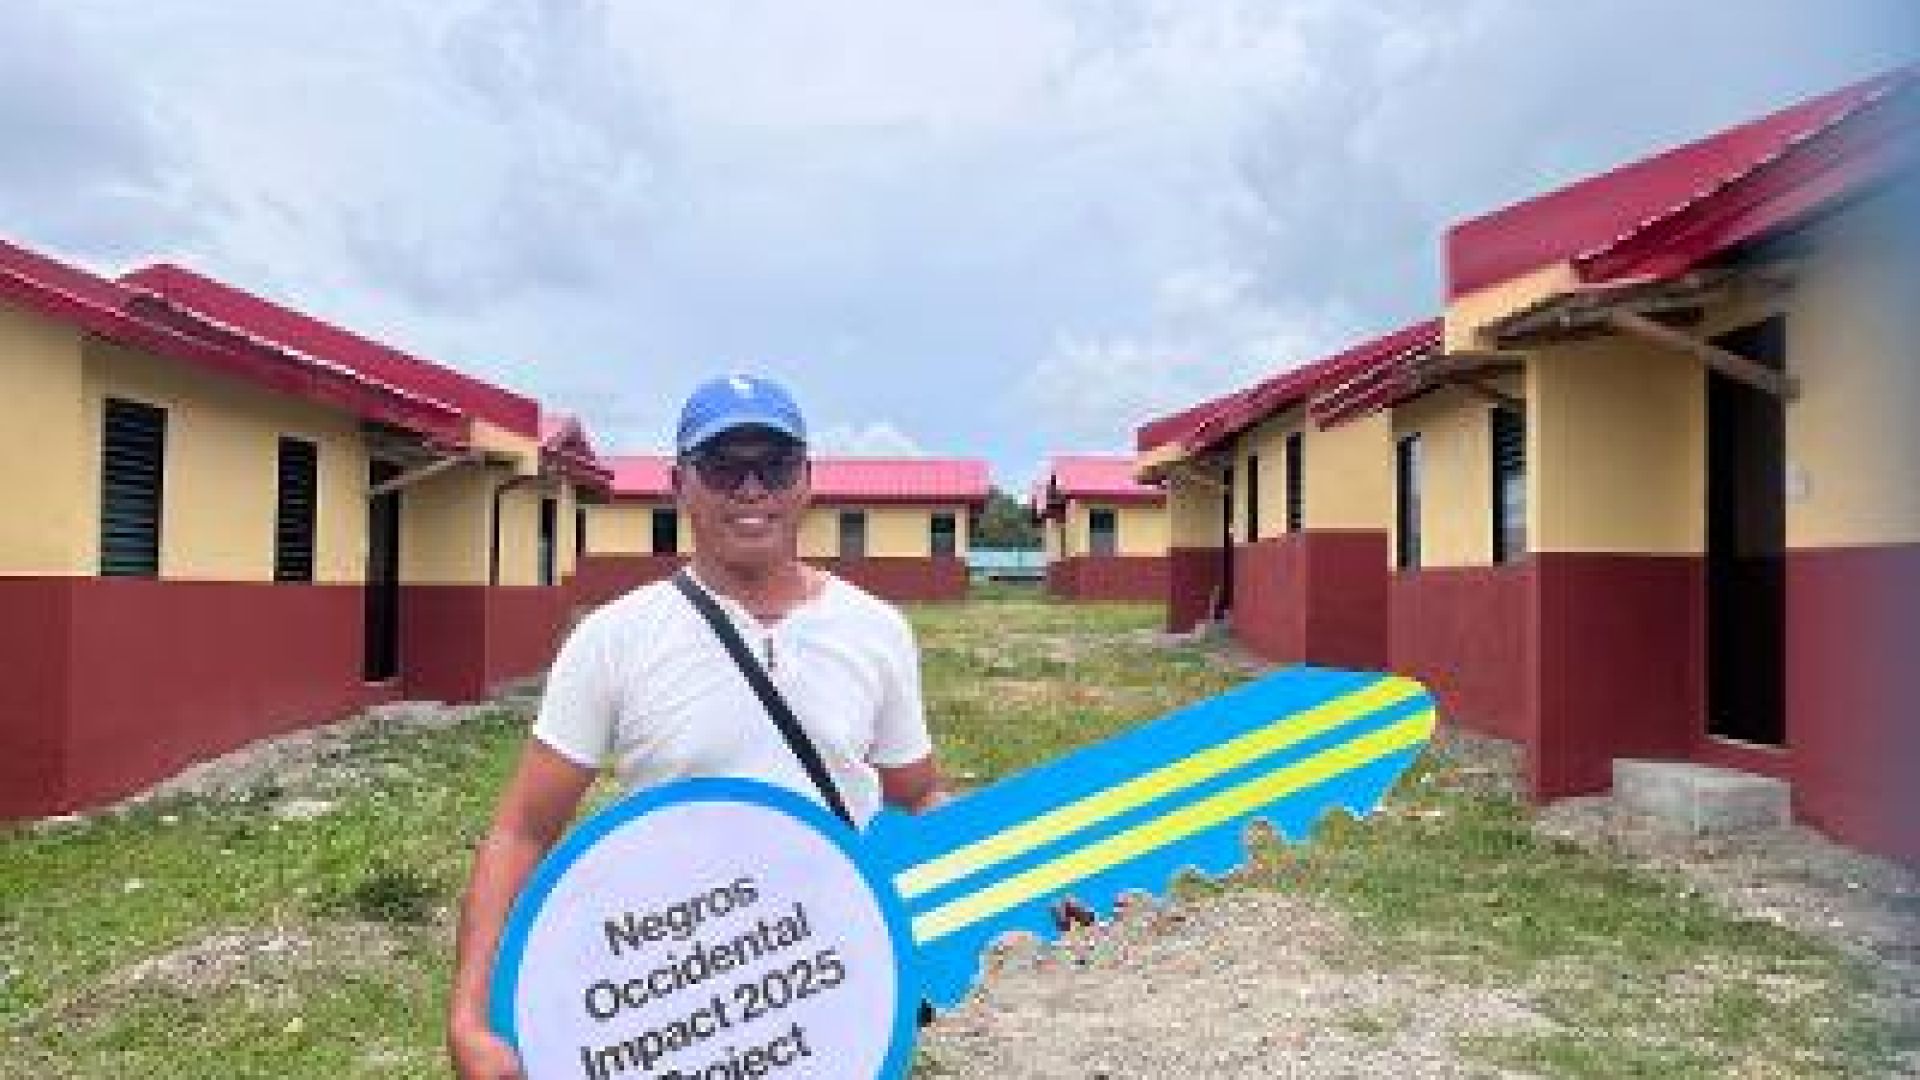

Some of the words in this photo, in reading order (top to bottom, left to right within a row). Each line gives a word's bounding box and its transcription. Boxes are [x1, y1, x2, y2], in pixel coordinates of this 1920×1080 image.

[585, 902, 811, 1019] Occidental
[604, 878, 759, 955] Negros
[581, 996, 730, 1080] Impact
[734, 949, 846, 1021] 2025
[657, 1022, 811, 1080] oject
